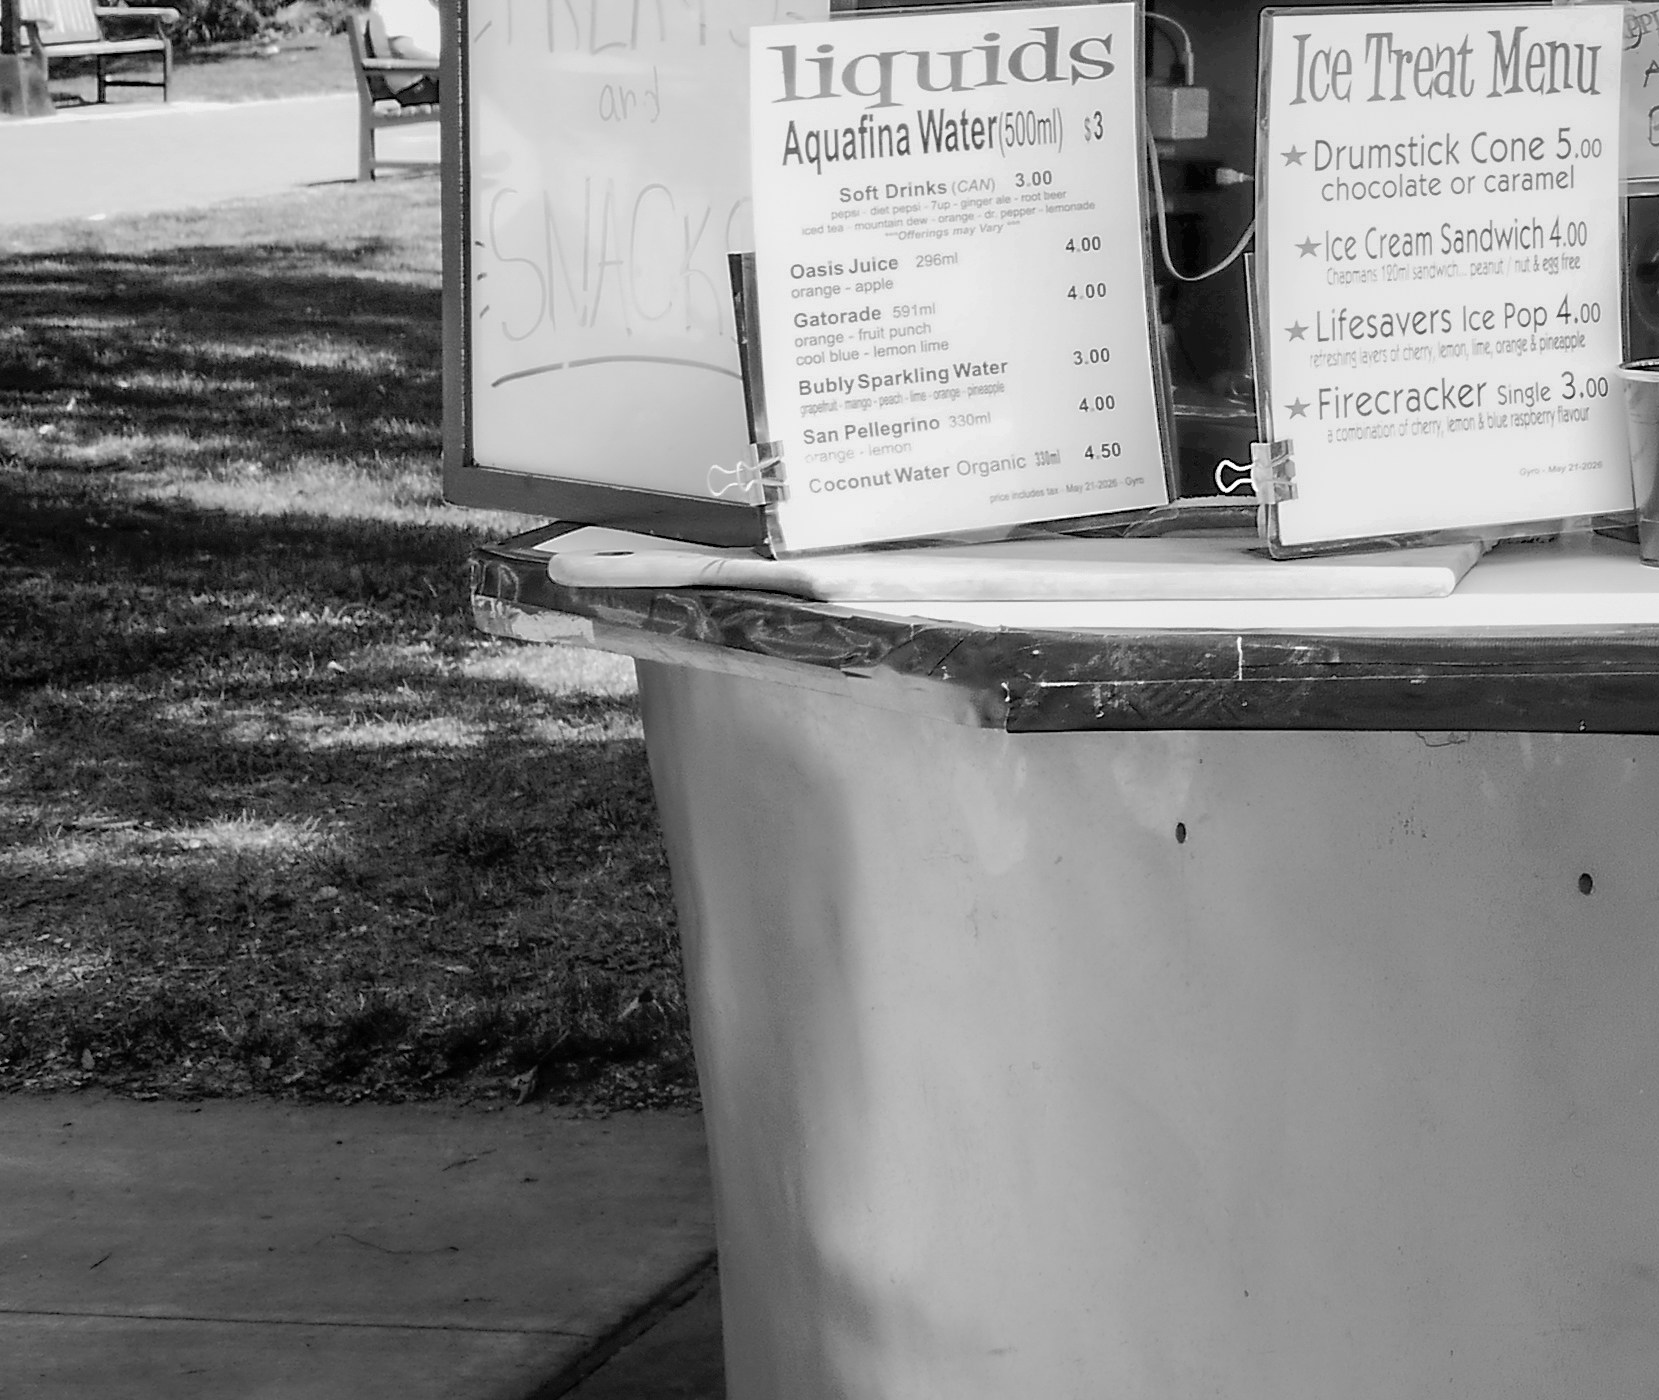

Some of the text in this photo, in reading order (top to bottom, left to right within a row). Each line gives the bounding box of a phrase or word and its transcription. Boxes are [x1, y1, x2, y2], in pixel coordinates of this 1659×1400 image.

[766, 27, 1115, 109] liquids
[1289, 27, 1602, 105] Ice Treat Menu
[599, 66, 661, 125] and
[782, 111, 1103, 175] Aquafina $3
[1314, 128, 1602, 171] Drumstick Cone 5.00
[839, 171, 1052, 204] Soft Drinks (CAN) 3.00
[1321, 165, 1575, 202] chocolate or caramel
[854, 201, 1096, 231] mountain lemonade
[1326, 215, 1588, 261] Ice Cream Sandwich 4.00
[790, 237, 1101, 279] Oasis Juice 296ml 4.00
[791, 278, 894, 299] orange apple
[794, 283, 1107, 328] Gatorade 591ml 4.00
[794, 323, 931, 349] orange fruit punch
[1317, 294, 1601, 342] Lifesavers Ice Pop 4.00
[795, 339, 949, 366] cool blue lemon lime
[799, 348, 1110, 396] Bubly Sparkling Water 3.00
[1319, 378, 1487, 419] Firecracker
[1561, 371, 1609, 399] 3.00
[803, 396, 1115, 445] San Pellegrino 330ml 4.00
[805, 441, 912, 465] orange lemon
[809, 443, 1121, 494] Coconut Water Organic 330ml 4.50
